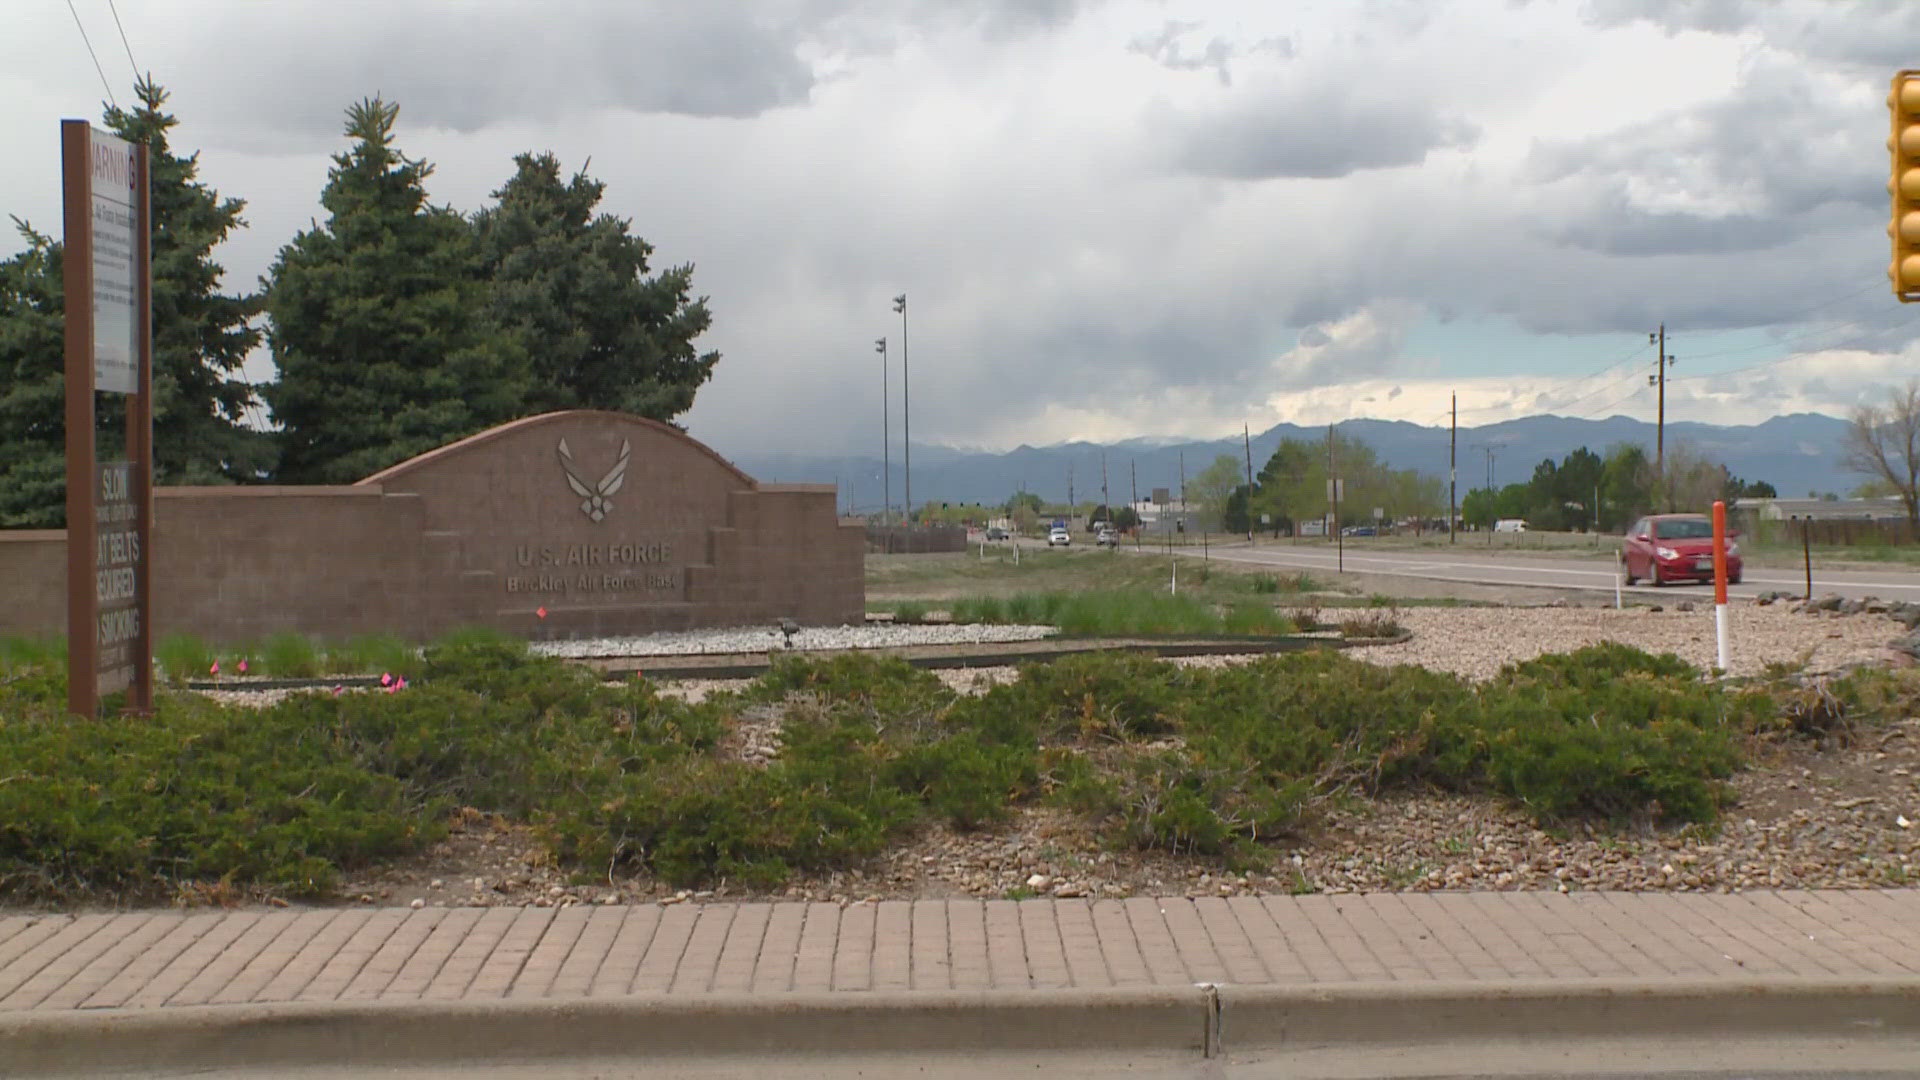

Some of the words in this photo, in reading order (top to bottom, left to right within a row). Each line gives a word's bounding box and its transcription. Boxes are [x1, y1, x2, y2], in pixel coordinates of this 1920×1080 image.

[110, 531, 140, 564] BELTS
[568, 543, 602, 566] AIR
[608, 541, 672, 563] FORCE
